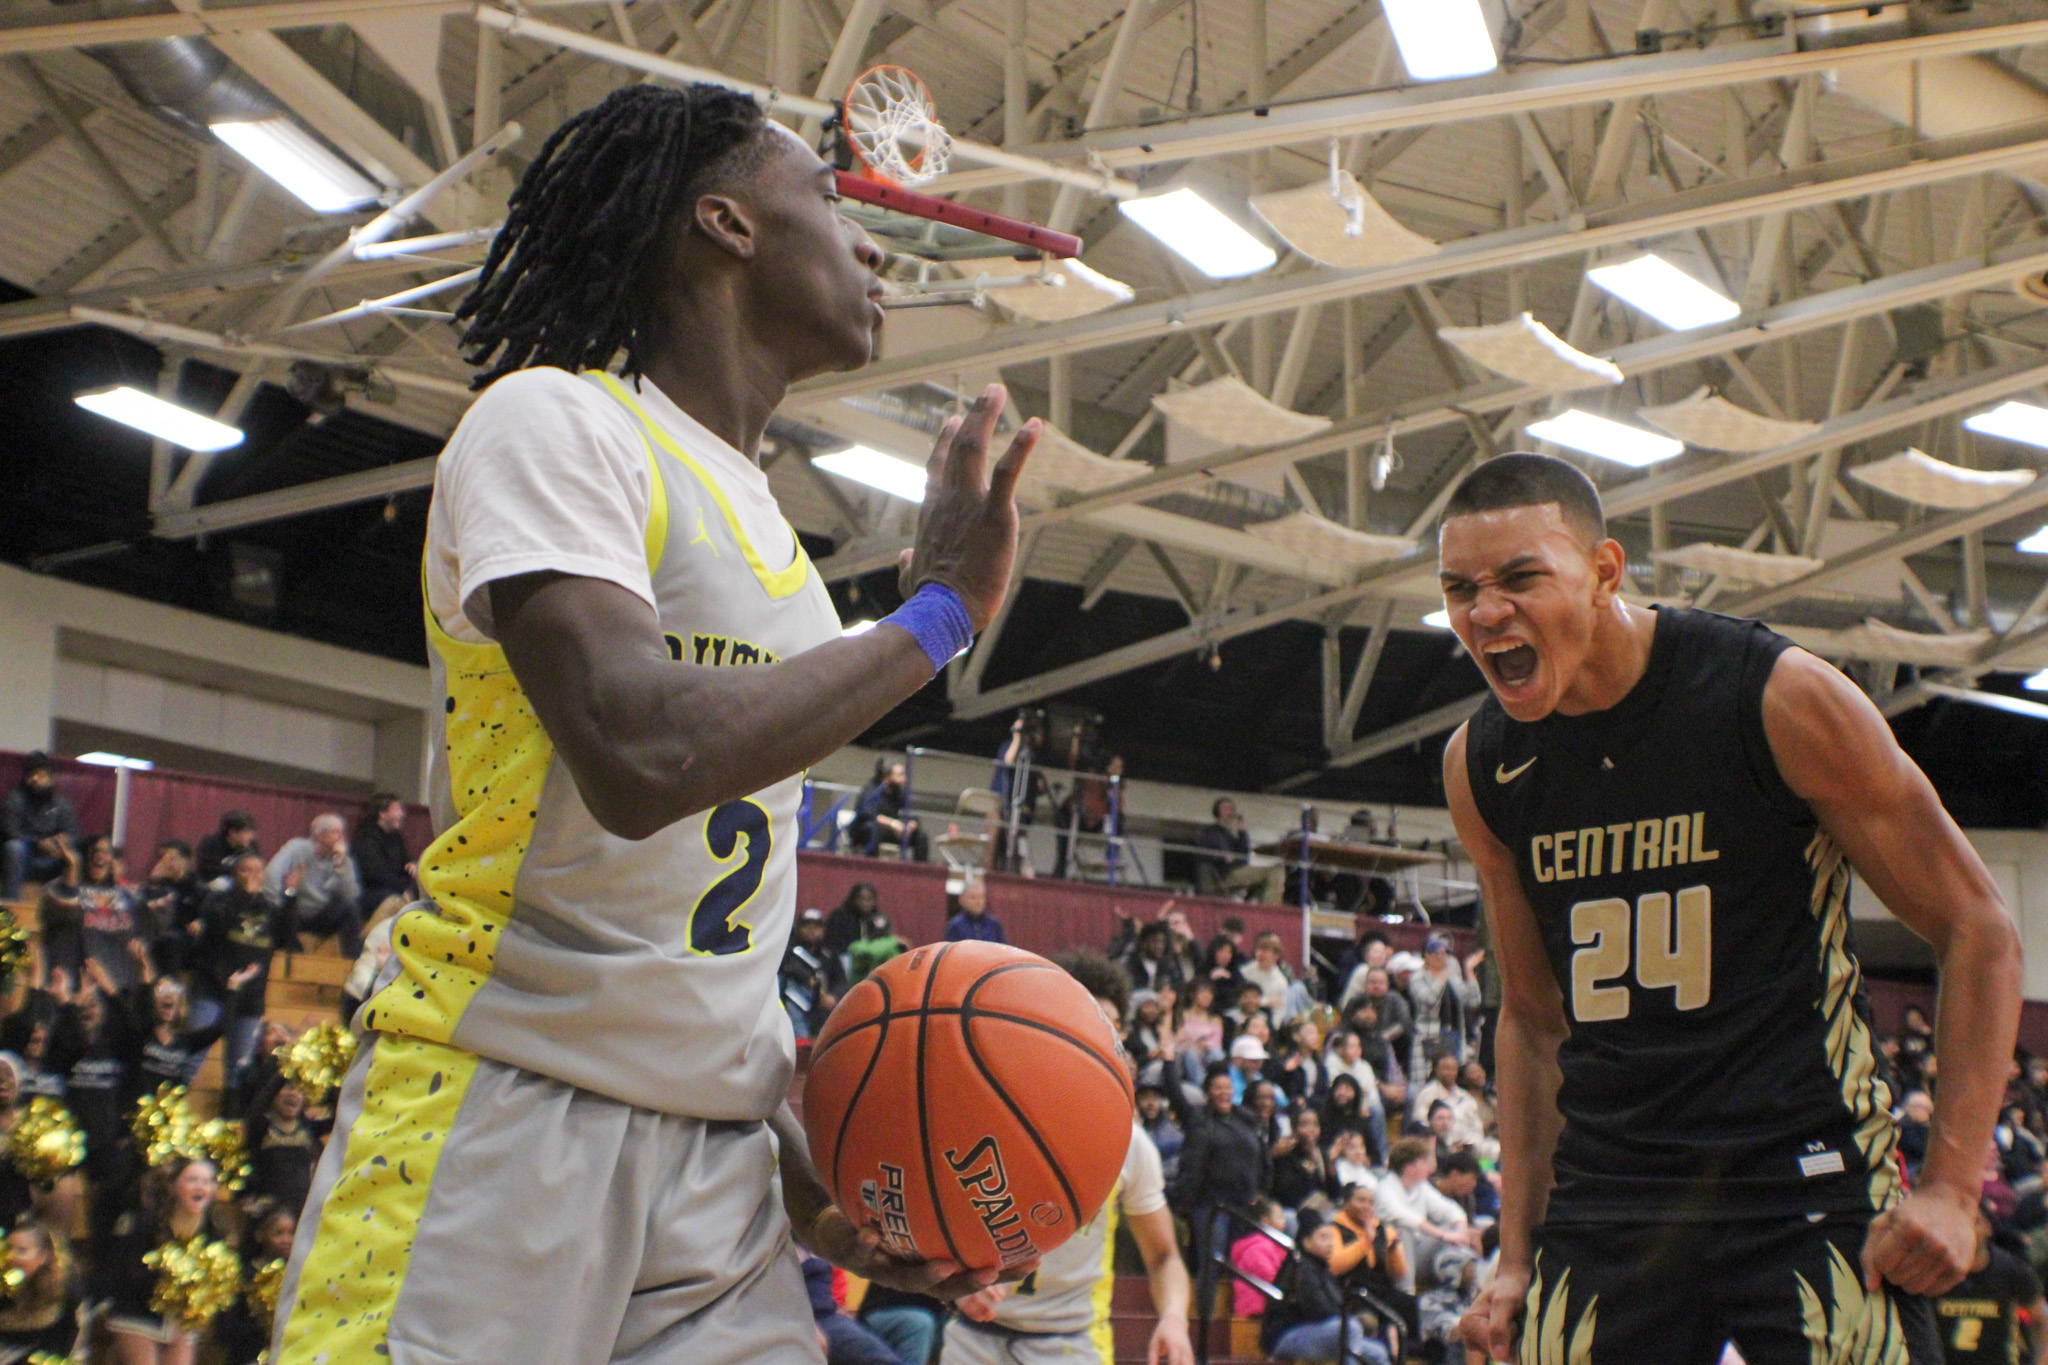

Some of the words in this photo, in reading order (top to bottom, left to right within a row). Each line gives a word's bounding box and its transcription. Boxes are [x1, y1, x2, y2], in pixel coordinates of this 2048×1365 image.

[685, 797, 773, 956] 2
[1532, 812, 1719, 882] CENTRAL
[1571, 885, 1711, 1022] 24
